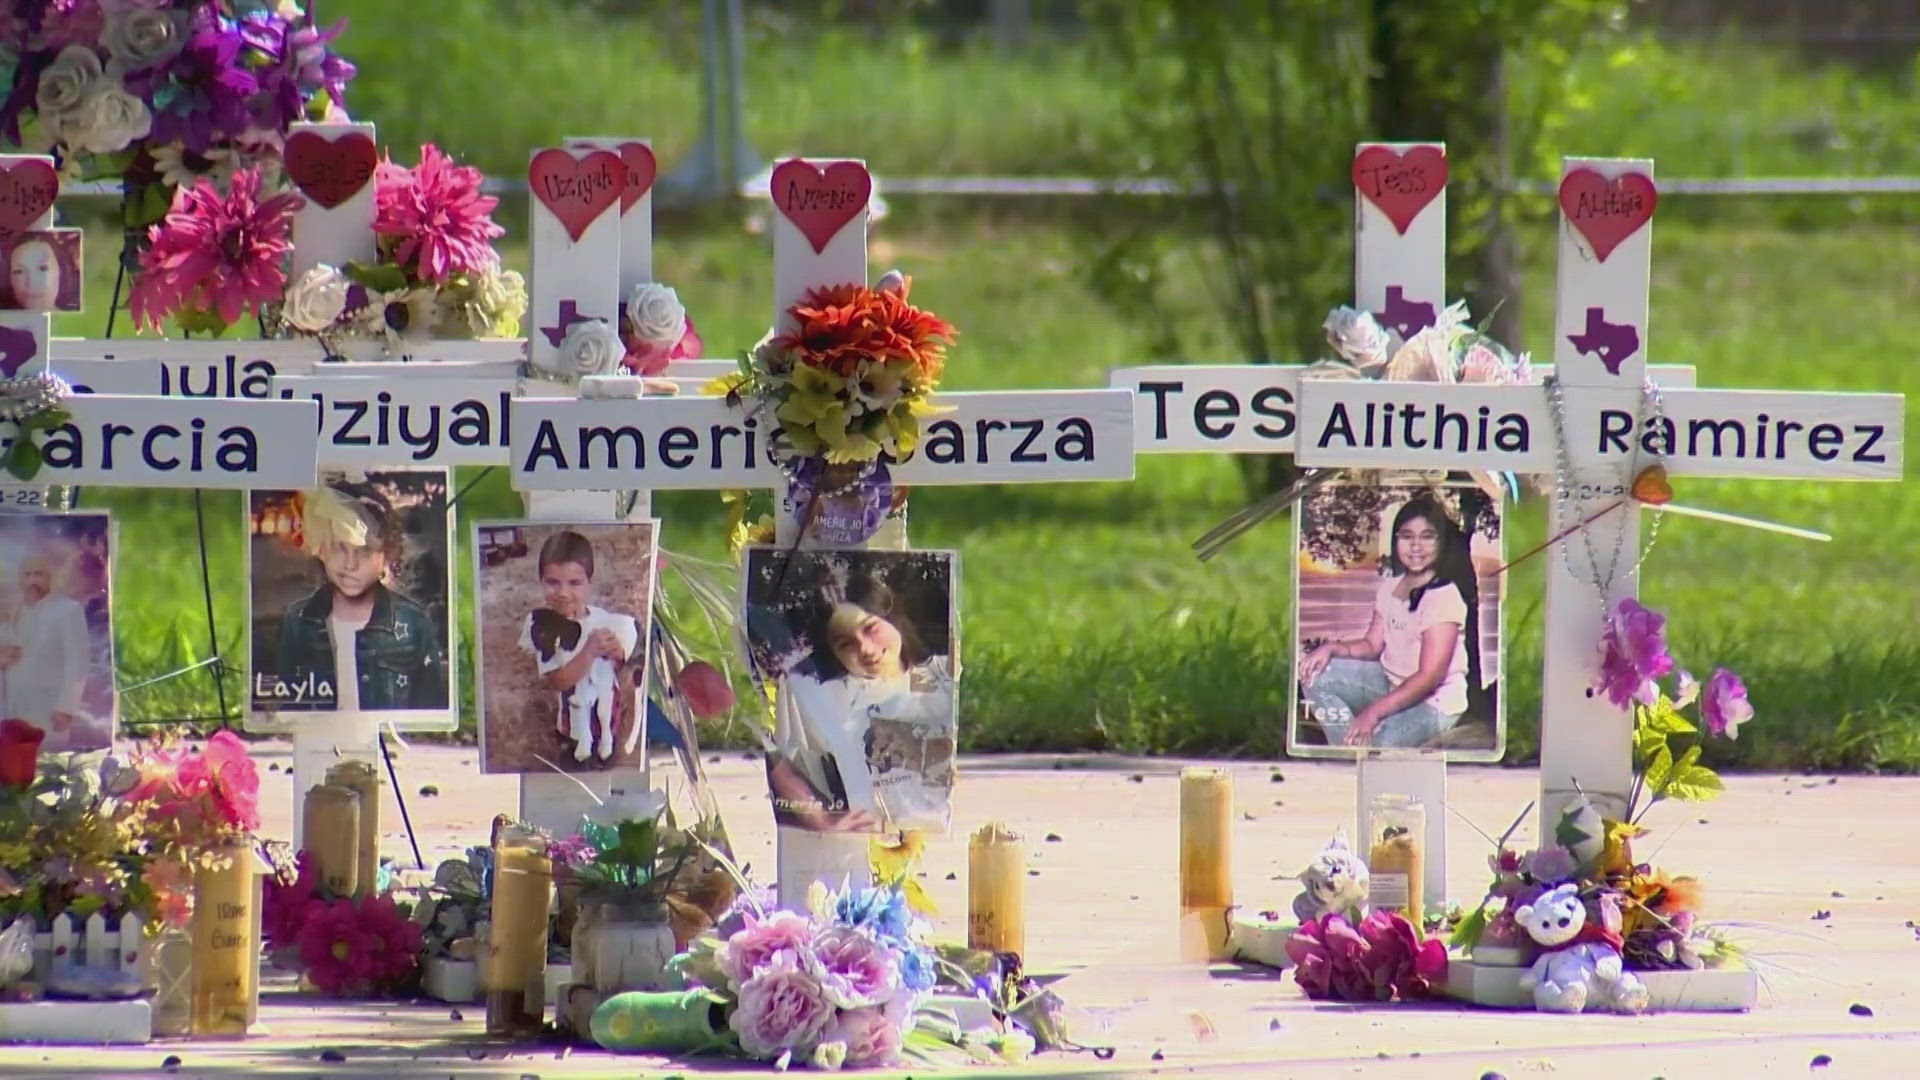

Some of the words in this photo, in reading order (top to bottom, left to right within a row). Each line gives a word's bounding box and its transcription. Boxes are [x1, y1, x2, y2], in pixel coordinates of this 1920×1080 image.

[543, 163, 613, 206] Uziyah
[1360, 163, 1427, 197] Tess
[0, 417, 258, 473] arcia
[878, 415, 1095, 465] arza
[1317, 402, 1530, 453] Alithia
[1598, 409, 1886, 463] Ramirez
[256, 671, 334, 702] Layla
[1300, 698, 1350, 721] Tess
